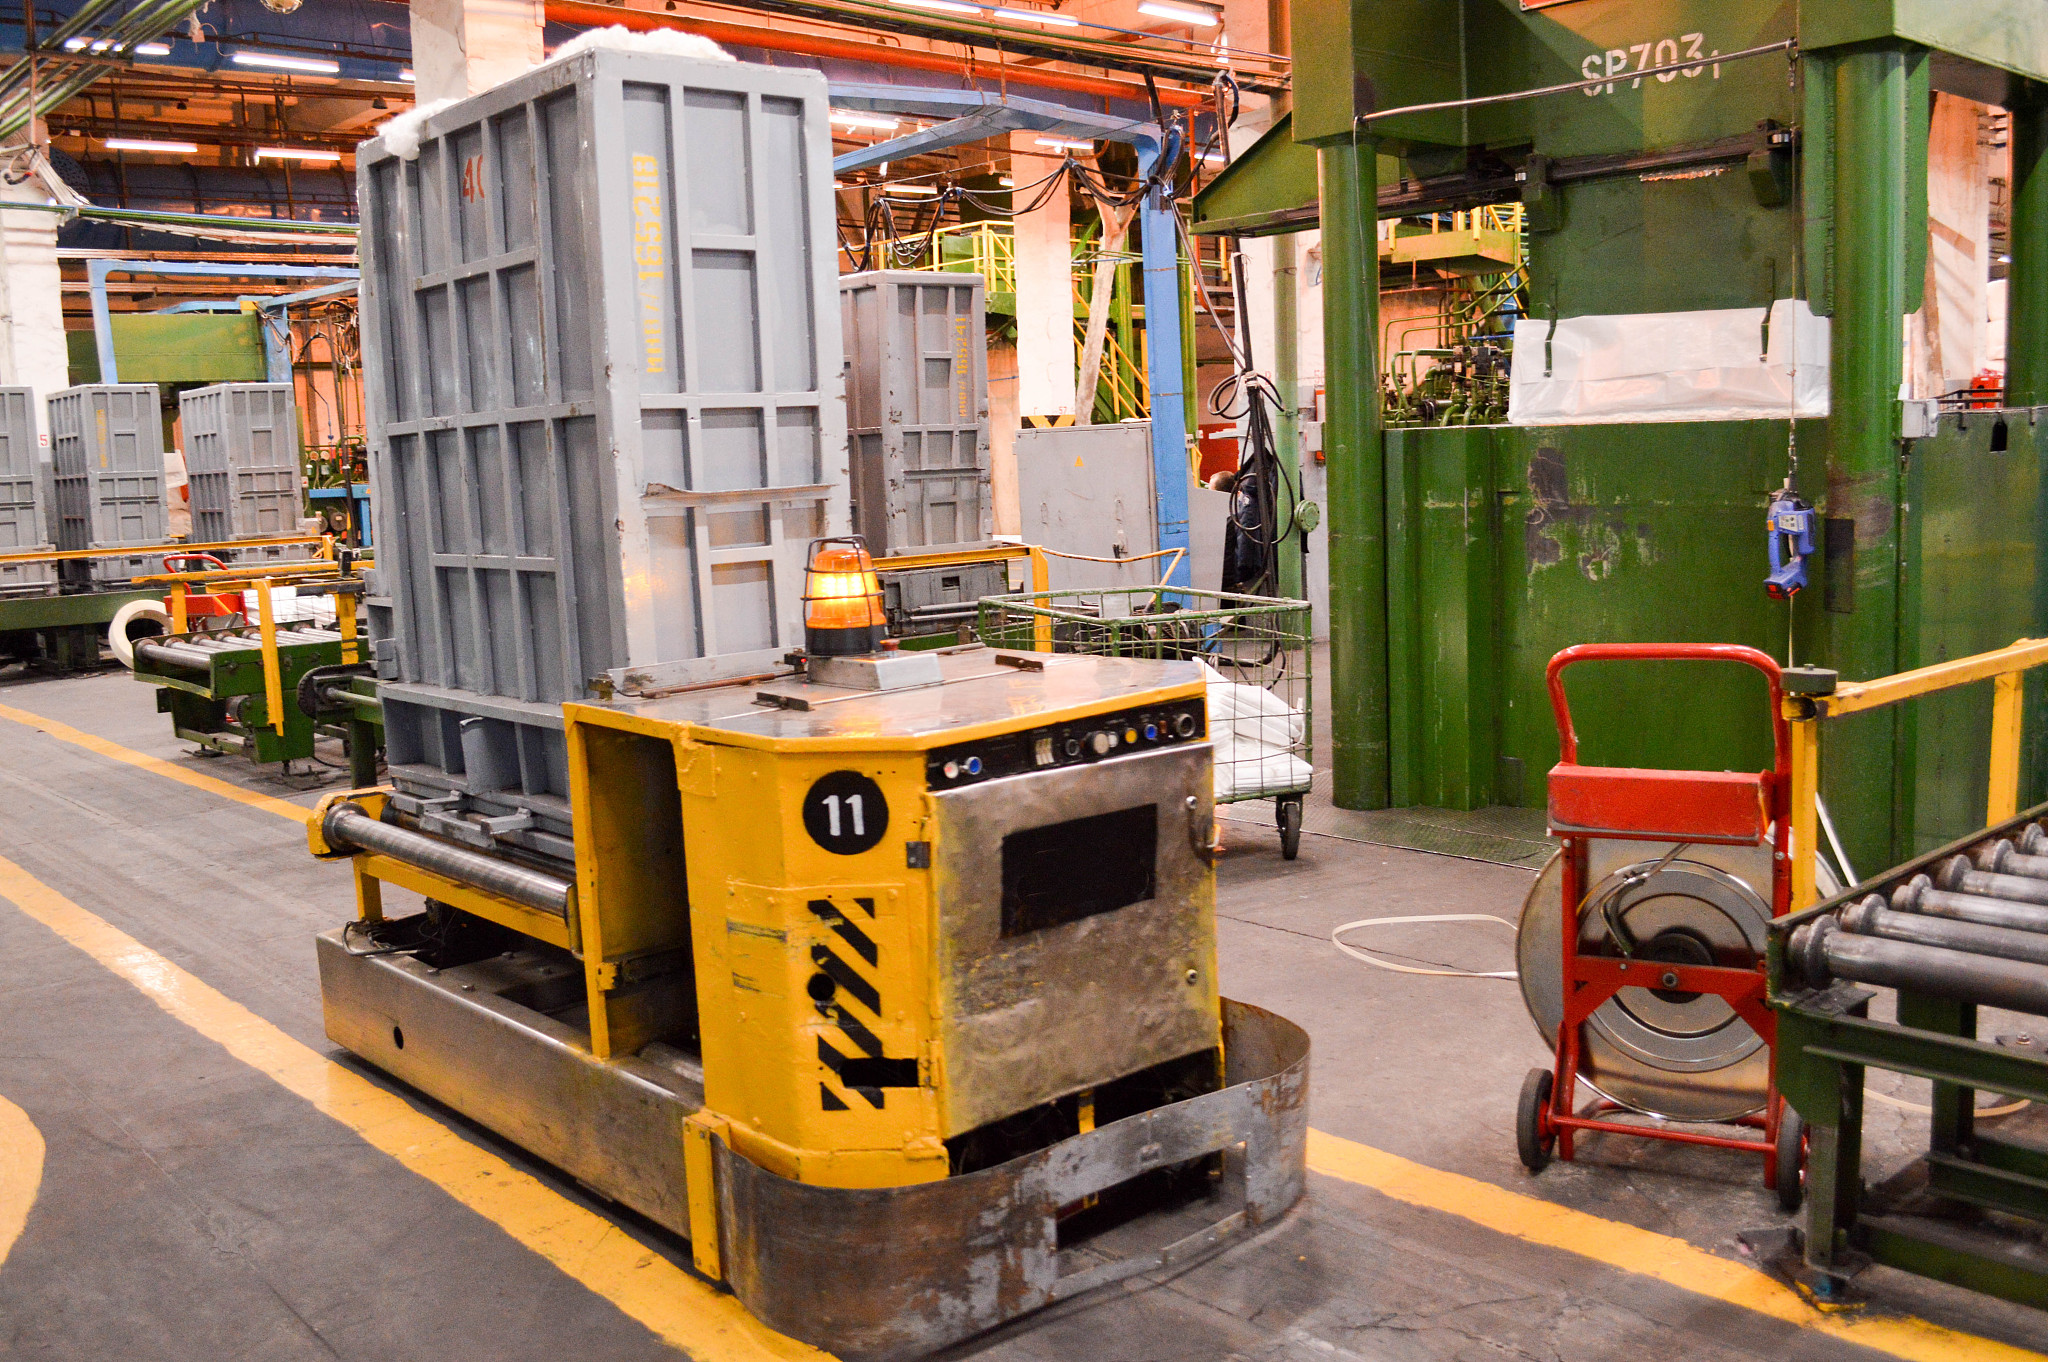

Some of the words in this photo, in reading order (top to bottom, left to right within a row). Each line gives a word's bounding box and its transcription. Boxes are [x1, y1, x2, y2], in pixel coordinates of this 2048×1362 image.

[633, 155, 664, 280] 165218
[40, 434, 49, 447] 5
[822, 794, 865, 836] 11
